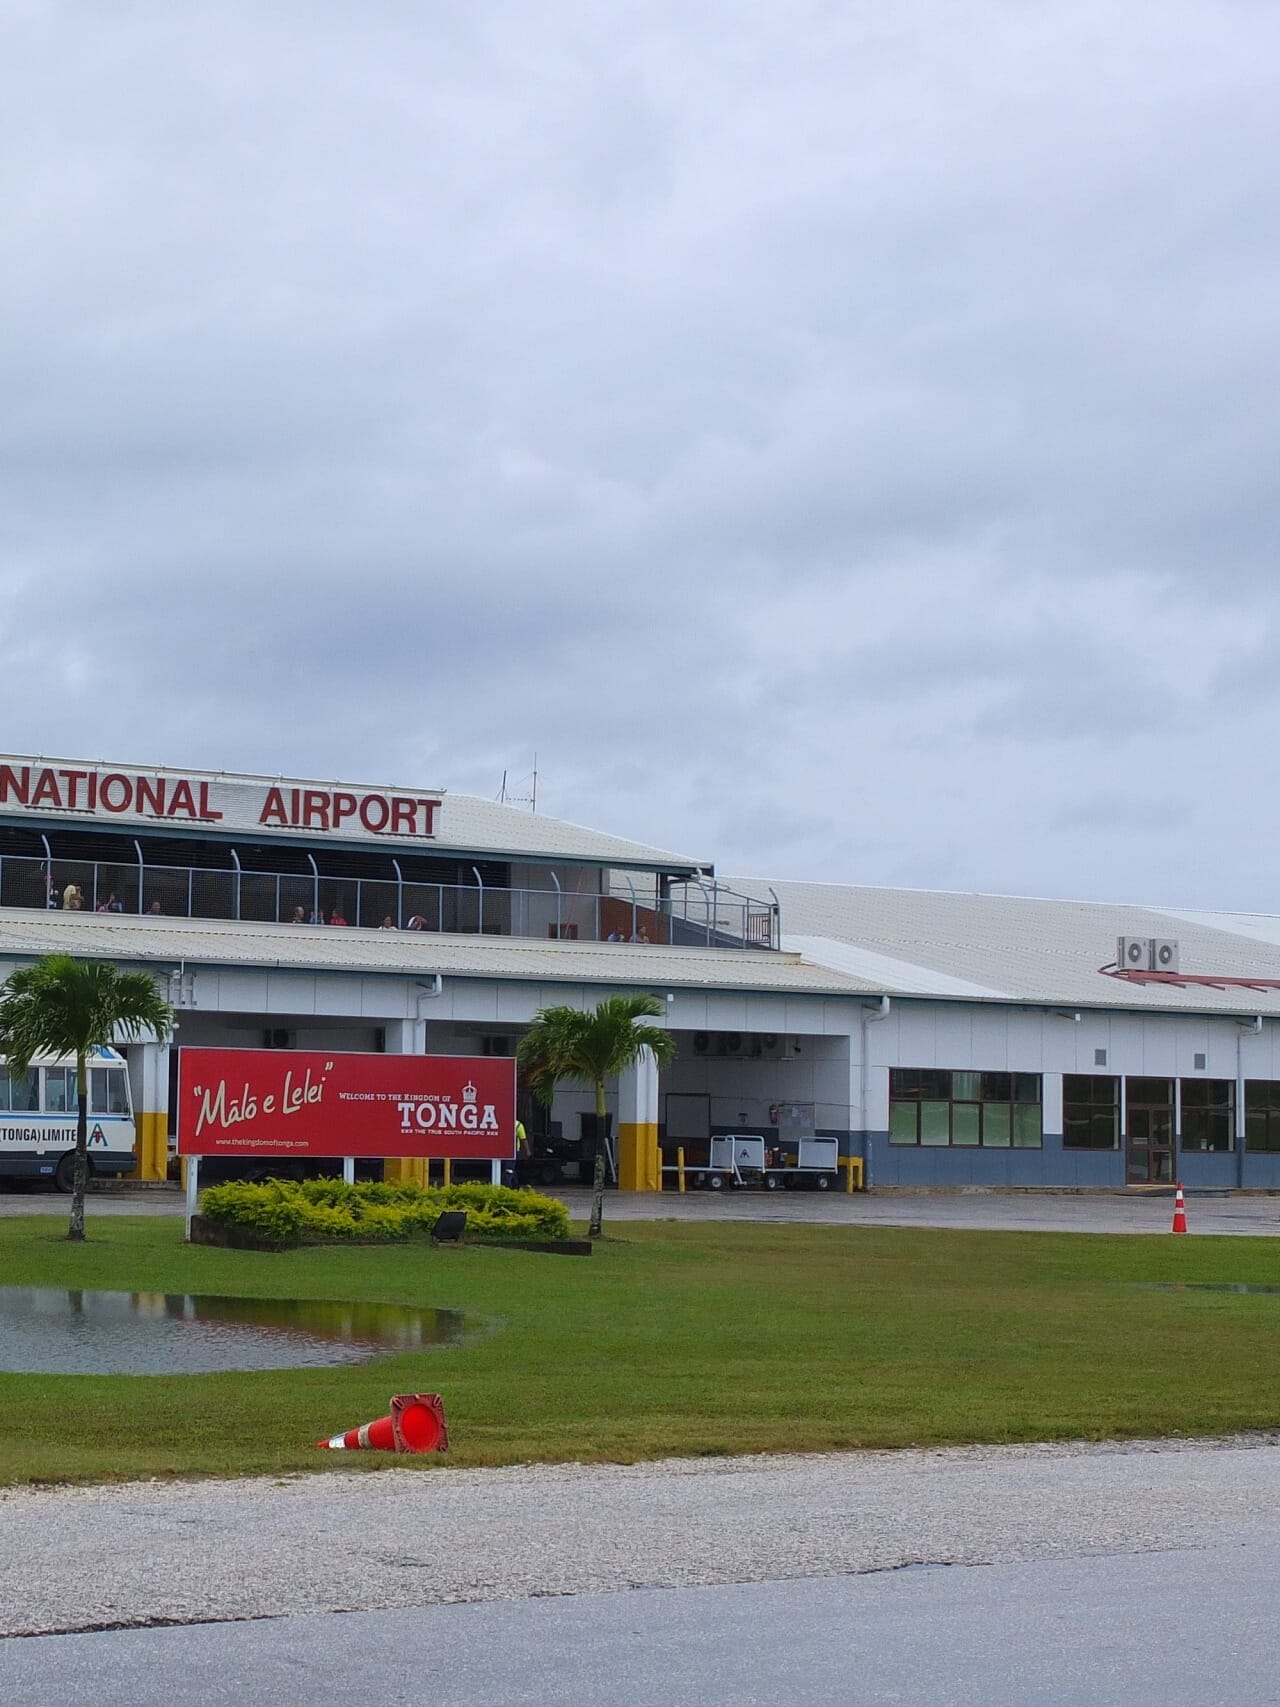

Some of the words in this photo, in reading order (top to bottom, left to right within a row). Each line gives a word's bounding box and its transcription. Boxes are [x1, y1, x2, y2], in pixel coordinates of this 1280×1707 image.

[259, 786, 442, 835] AIRPORT
[263, 1095, 276, 1113] e
[339, 1092, 375, 1101] WELCOME
[376, 1093, 386, 1101] TO
[404, 1094, 440, 1102] KINGDOM
[397, 1102, 499, 1129] TONGA
[42, 1128, 77, 1142] LIMITE
